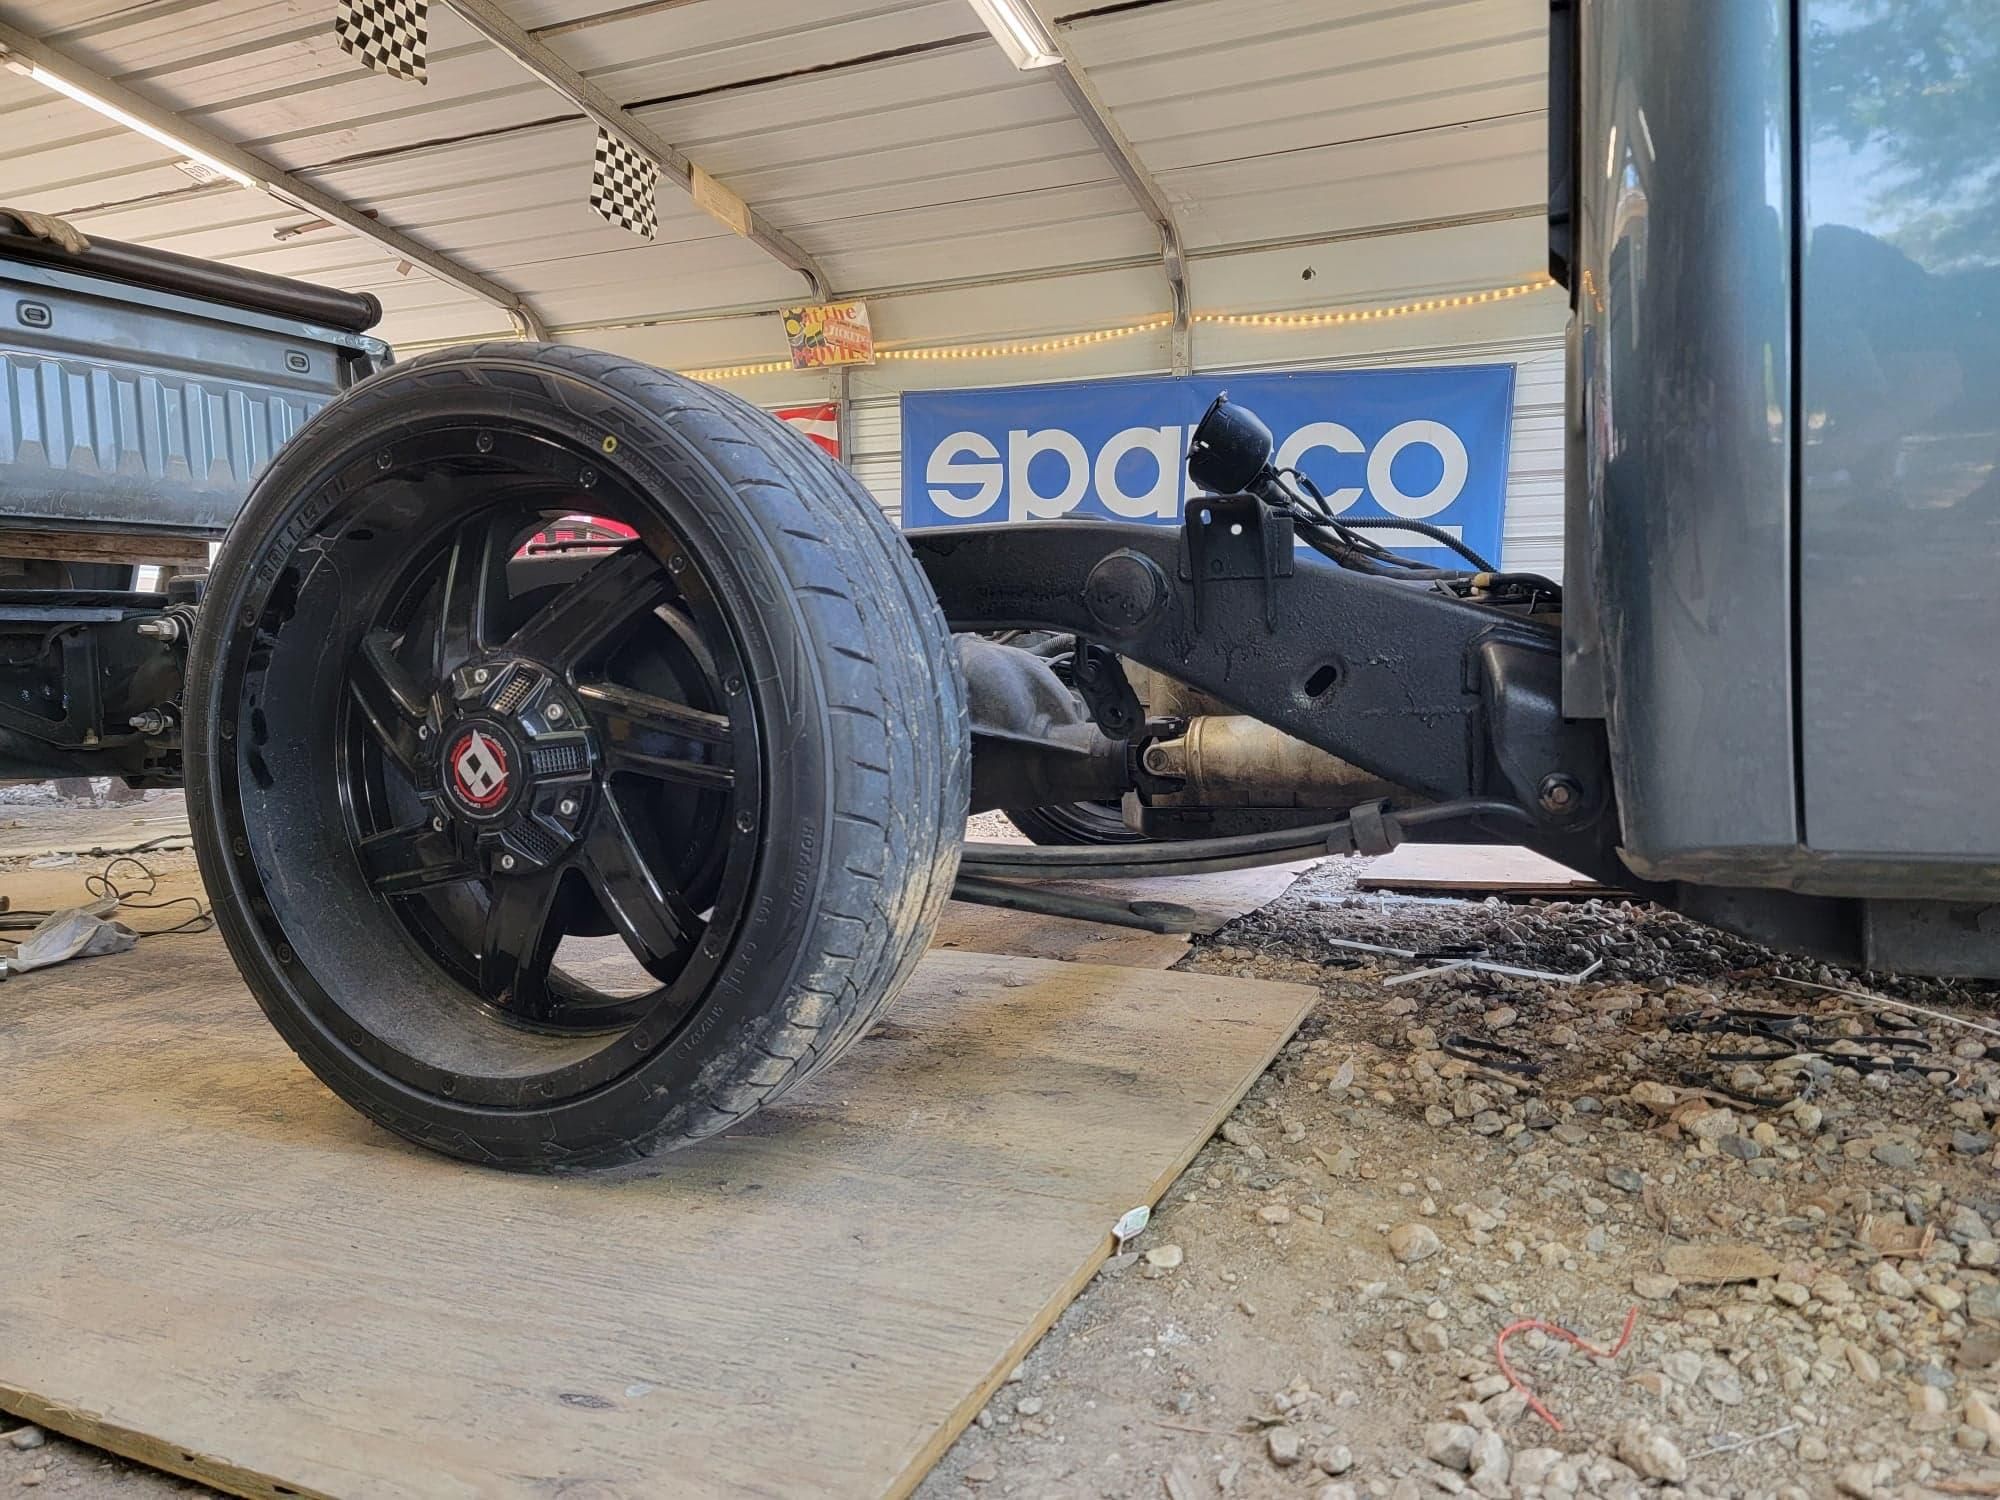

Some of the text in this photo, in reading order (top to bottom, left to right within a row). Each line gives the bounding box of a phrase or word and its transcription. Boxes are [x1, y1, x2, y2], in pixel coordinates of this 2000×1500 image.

[824, 305, 857, 321] the
[925, 418, 1470, 521] spaco
[791, 825, 816, 908] ROTATION
